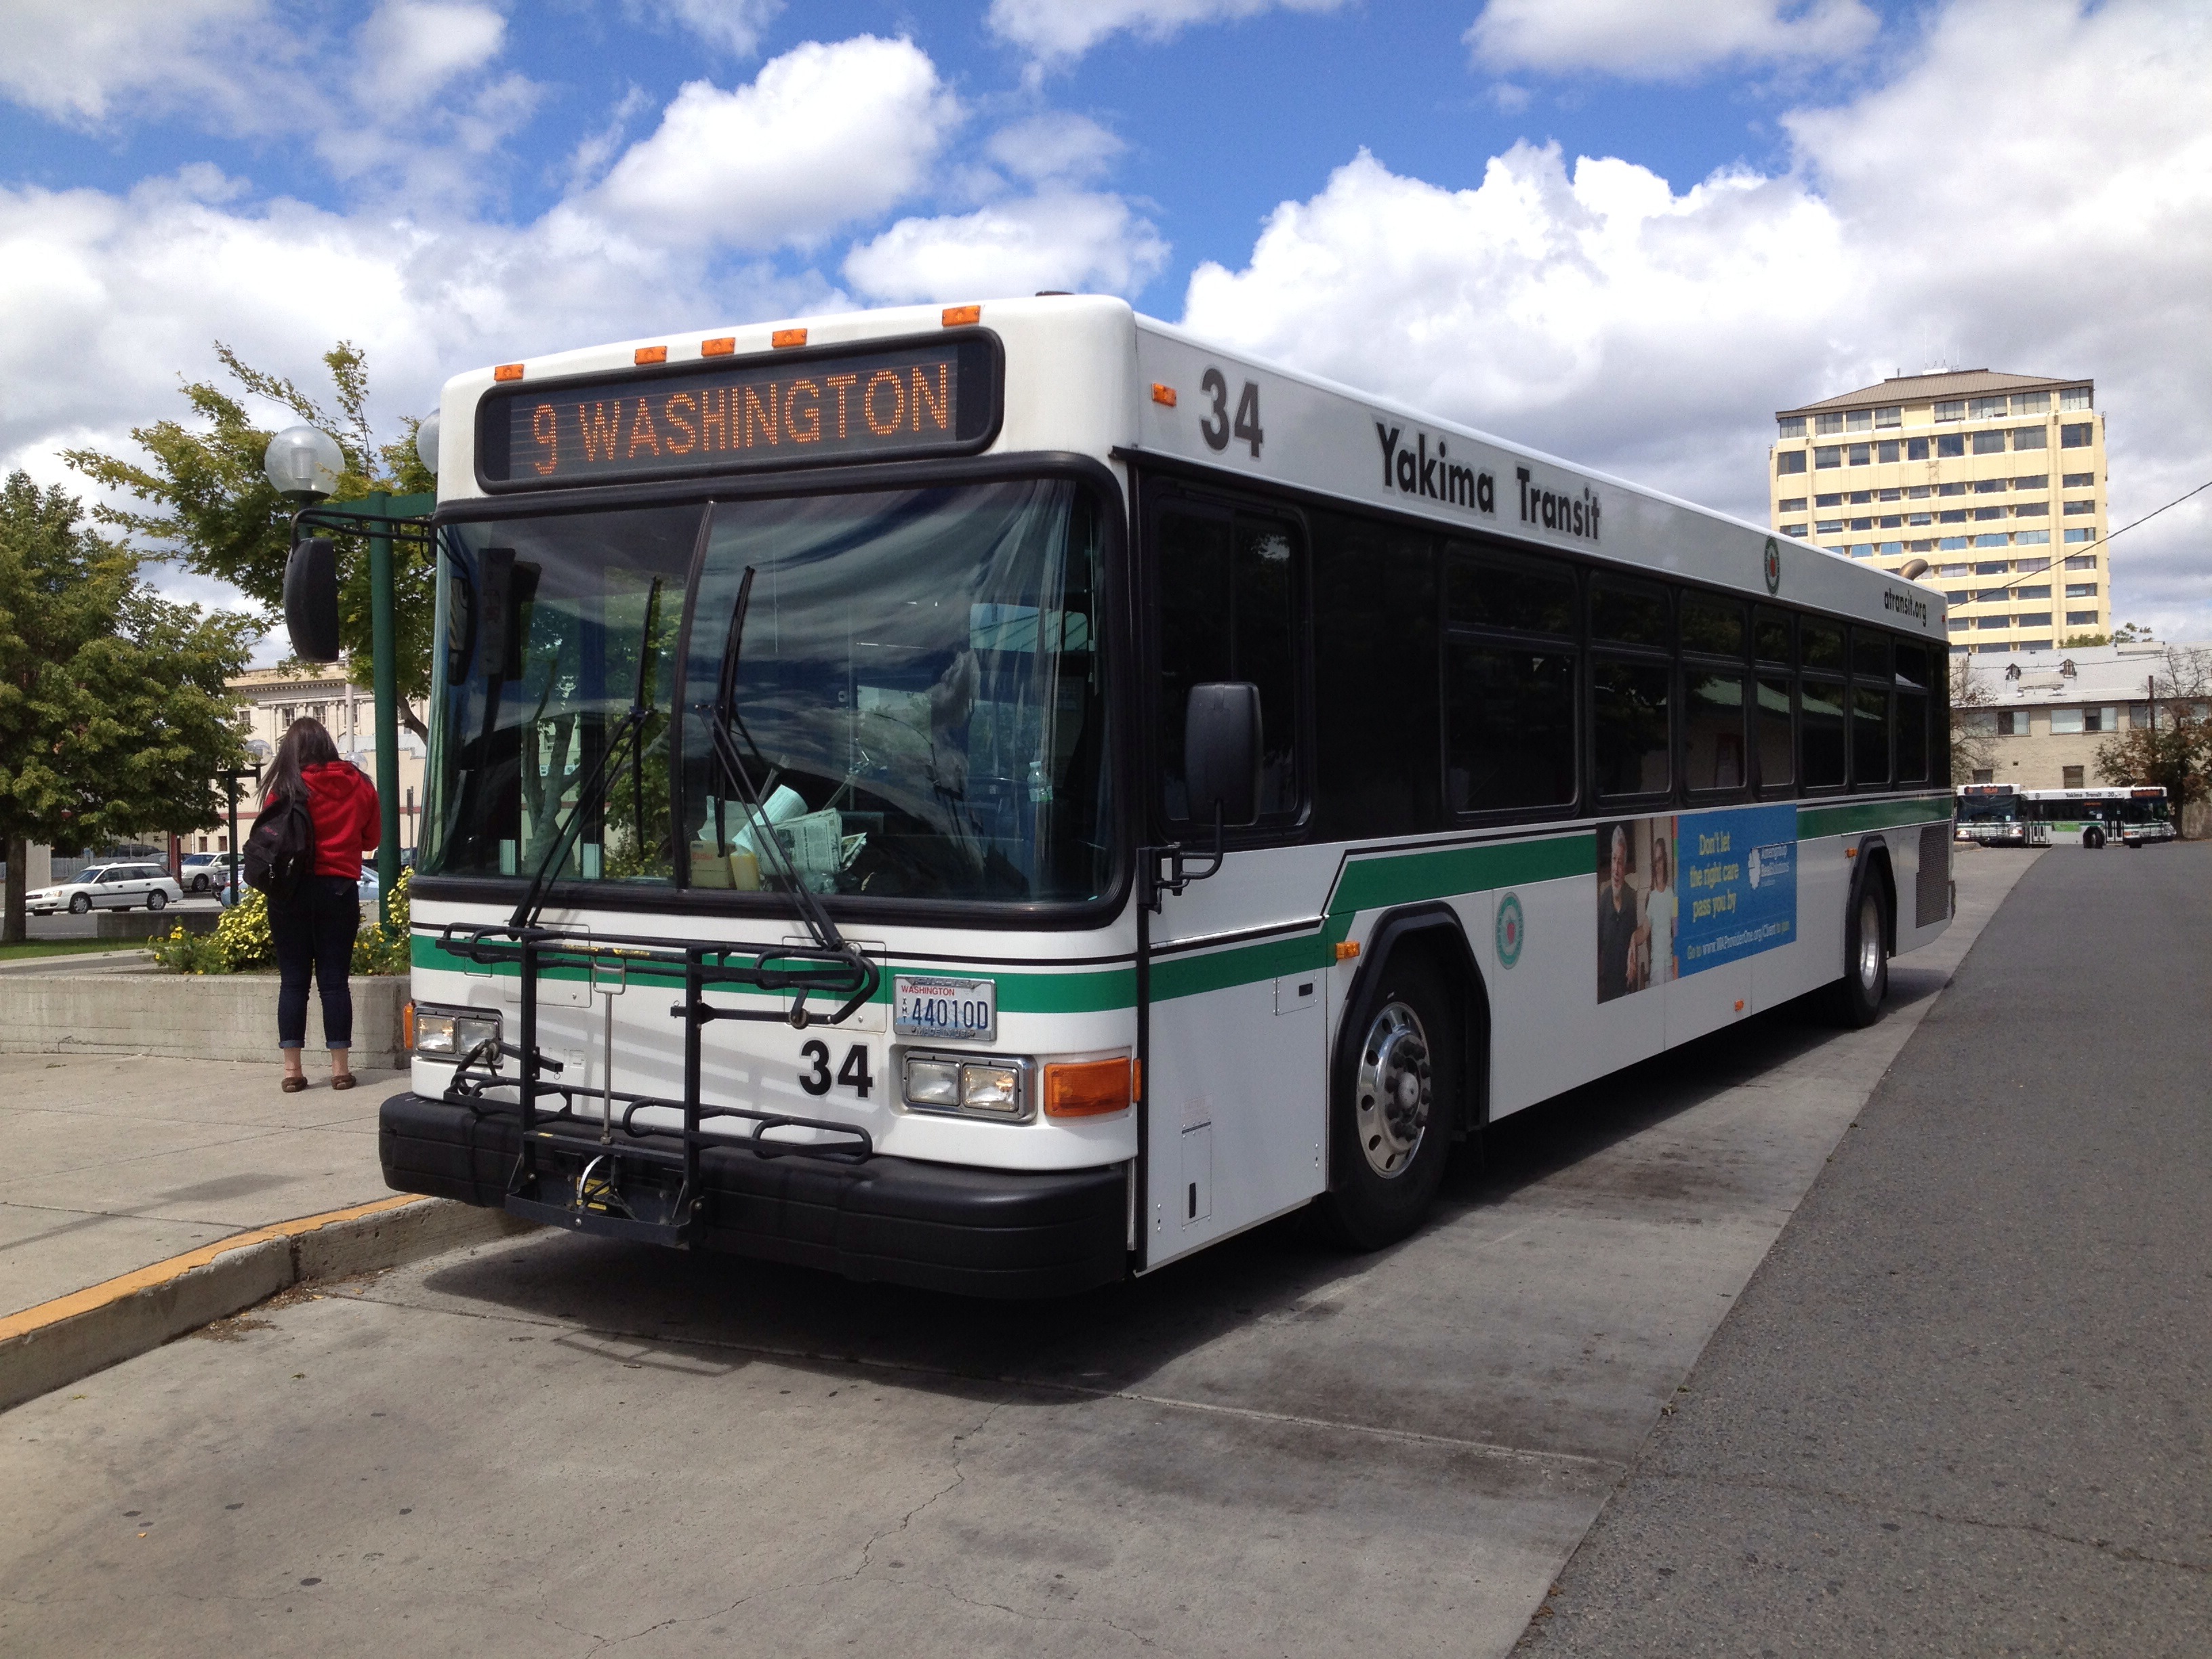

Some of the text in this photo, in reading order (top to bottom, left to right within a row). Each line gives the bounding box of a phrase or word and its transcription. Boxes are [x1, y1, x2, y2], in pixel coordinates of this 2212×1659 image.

[532, 363, 947, 475] 9 WASHINGTON
[1200, 367, 1264, 458] 34
[1375, 422, 1601, 540] Yakima Transit
[1884, 587, 1927, 628] atransit.org
[901, 985, 955, 996] WASHINGTON
[912, 997, 989, 1029] 44010D
[798, 1039, 874, 1099] 34
